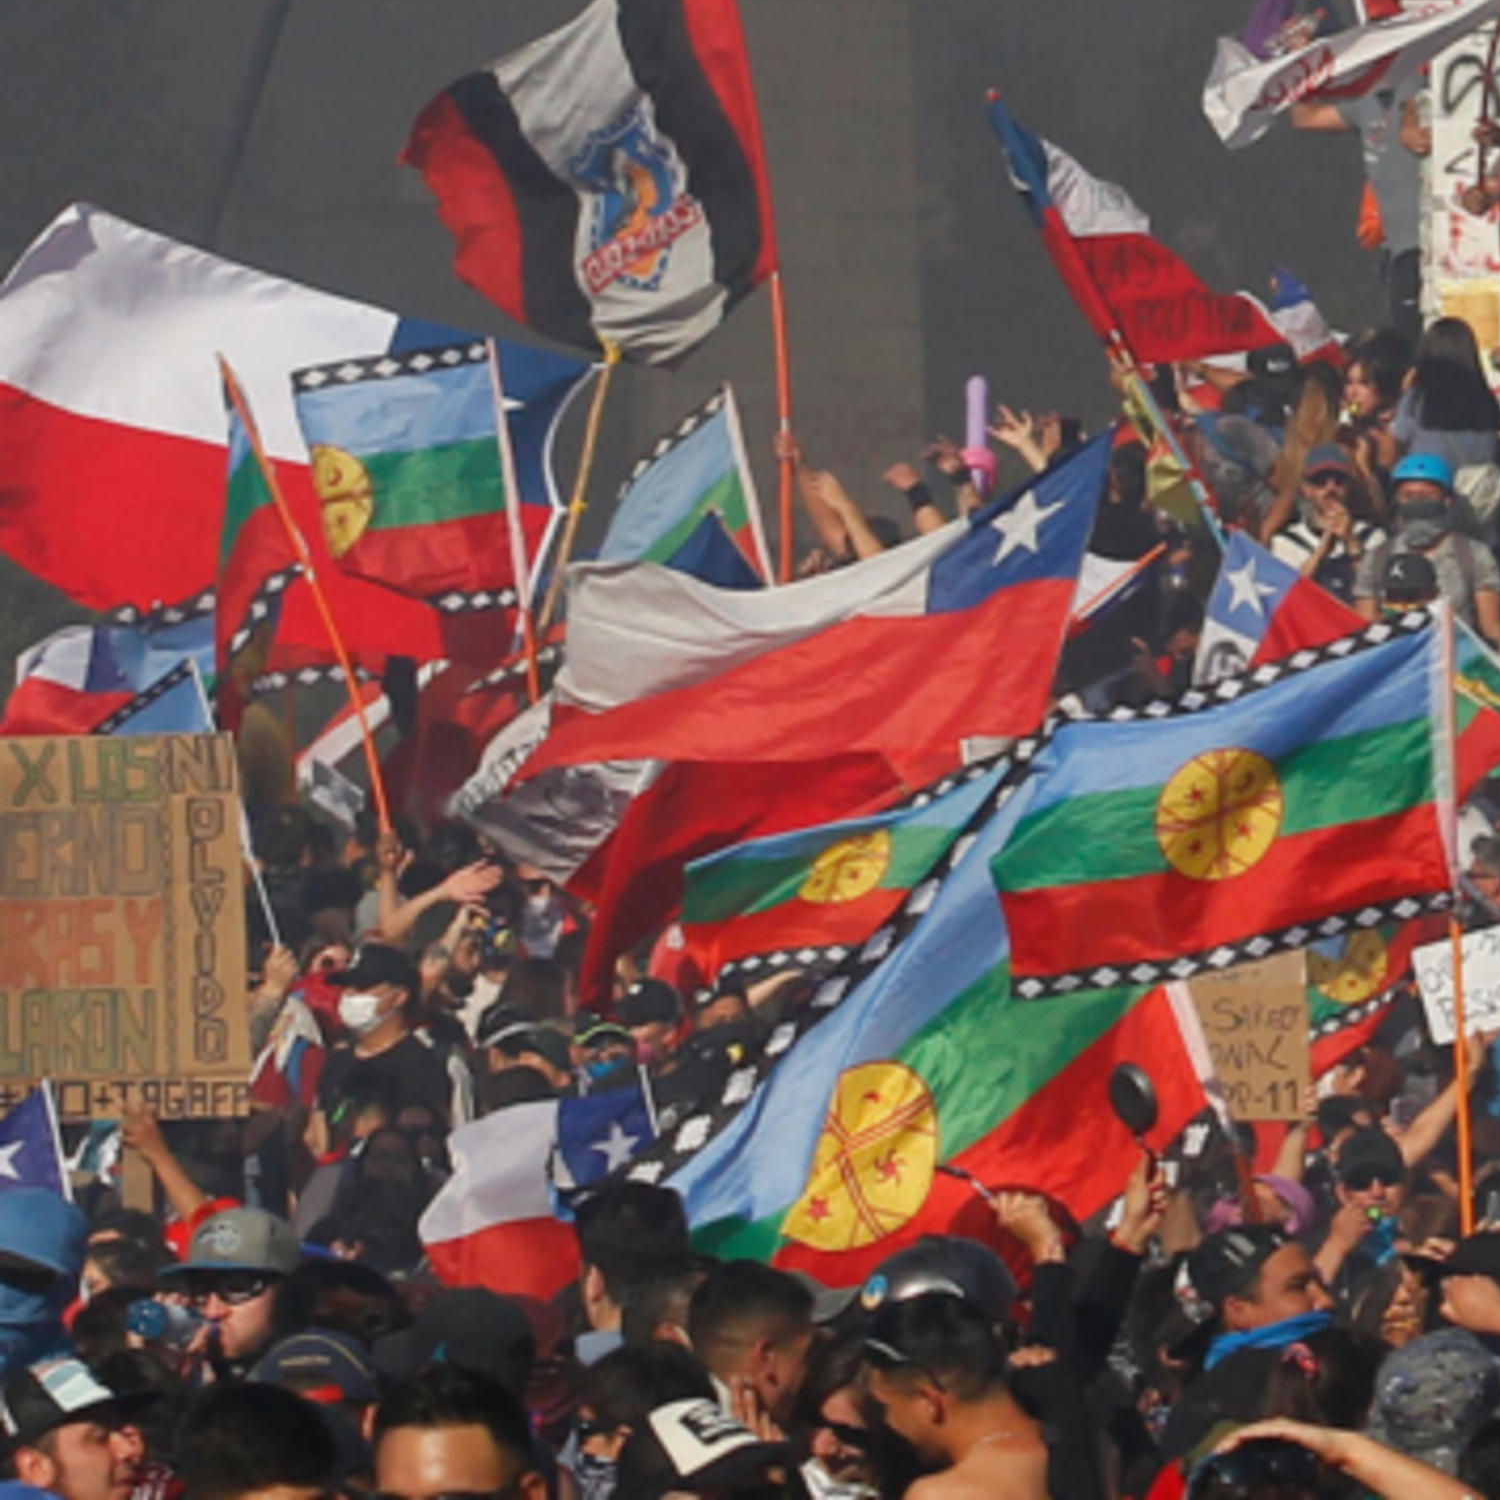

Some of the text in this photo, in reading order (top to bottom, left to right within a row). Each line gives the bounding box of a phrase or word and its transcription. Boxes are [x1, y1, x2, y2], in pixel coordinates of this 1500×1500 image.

[8, 739, 159, 807] X LOS
[166, 736, 232, 793] NI
[186, 797, 228, 1065] OLVIDO
